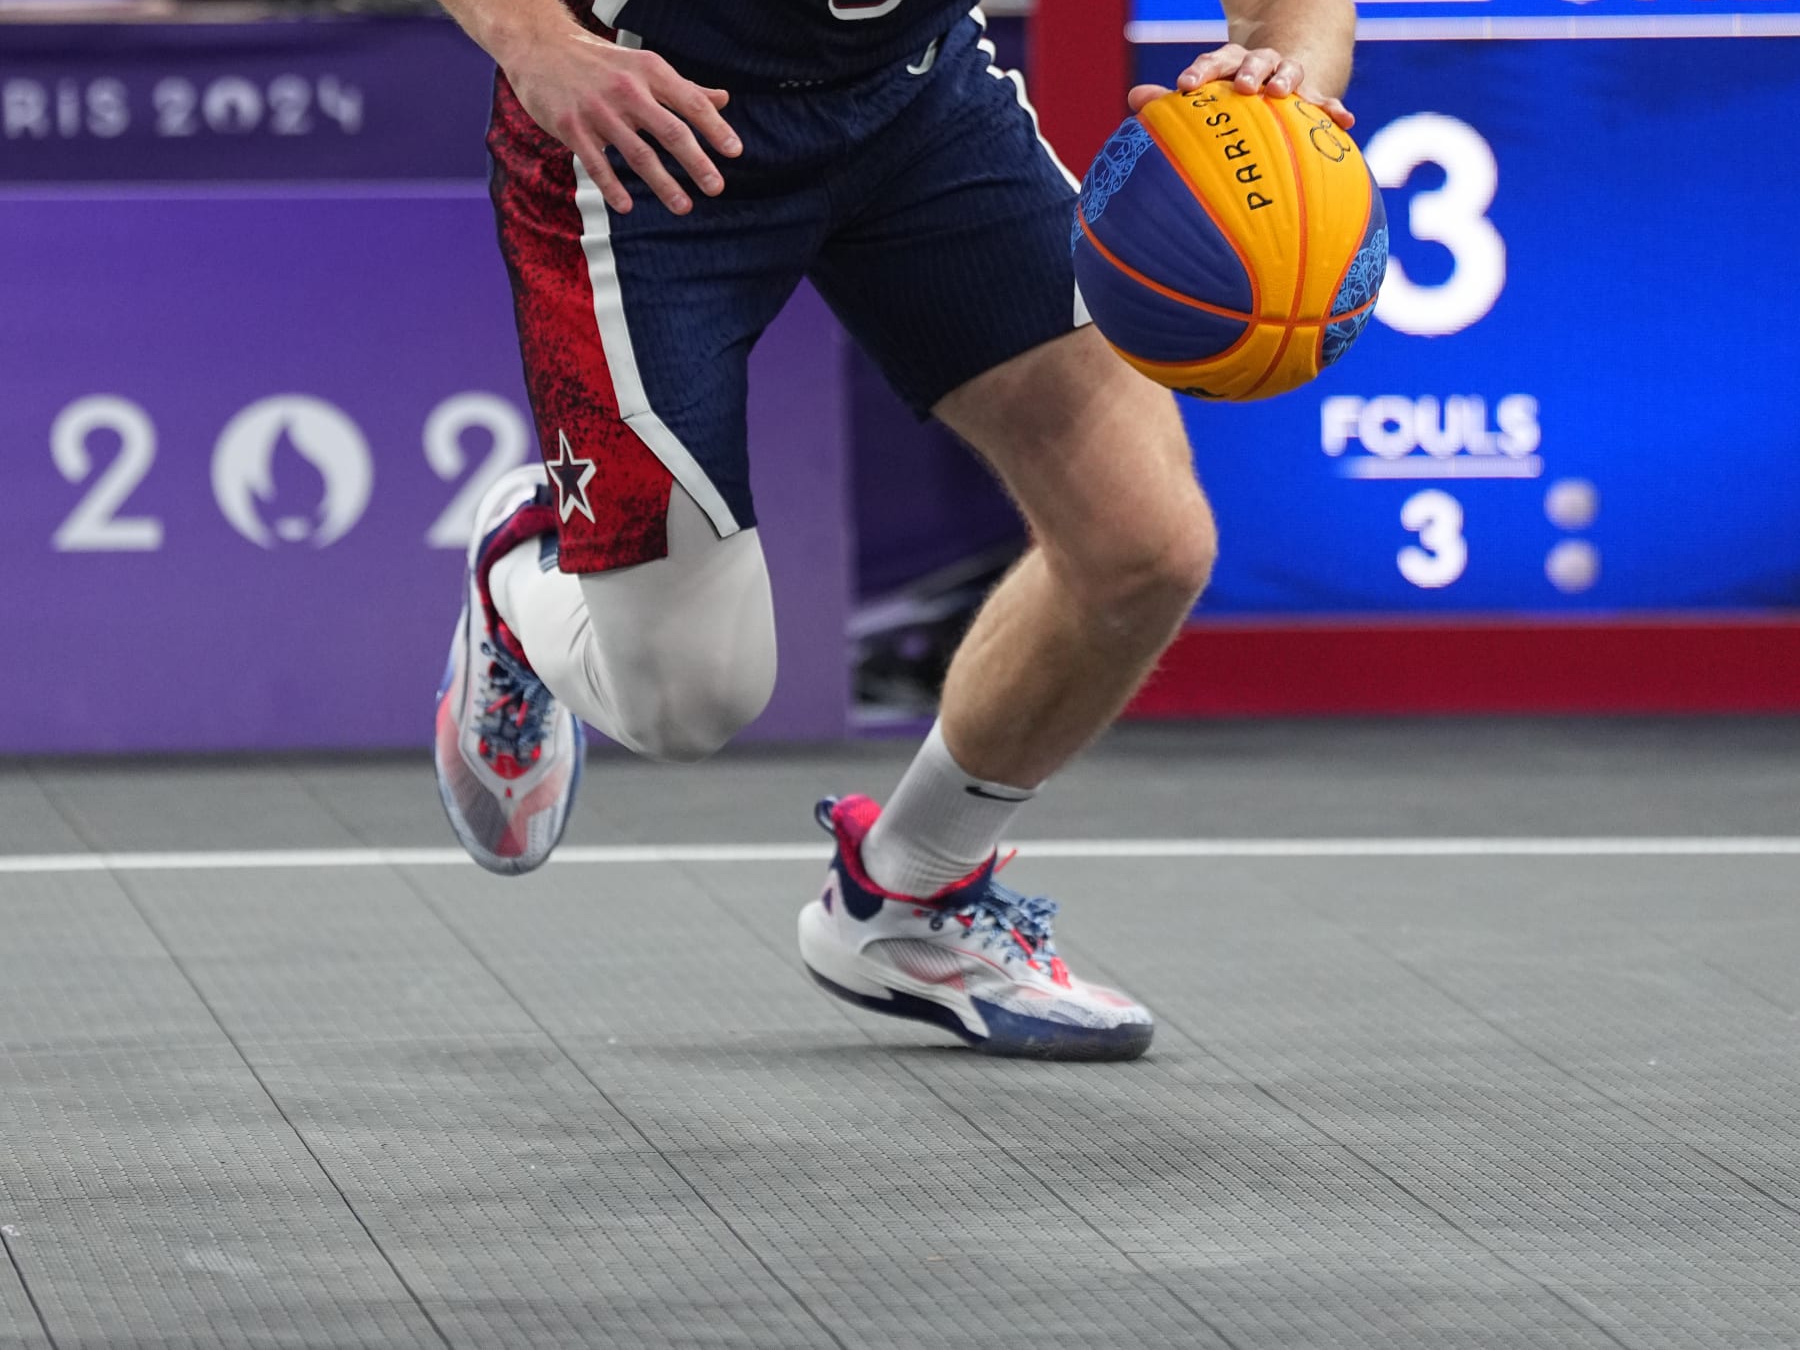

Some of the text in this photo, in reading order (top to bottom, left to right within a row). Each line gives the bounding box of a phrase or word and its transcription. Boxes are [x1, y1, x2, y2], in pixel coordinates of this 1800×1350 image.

[153, 74, 364, 138] 2024
[1363, 112, 1506, 337] 3
[1321, 394, 1541, 458] FOULS
[1397, 490, 1468, 589] 3
